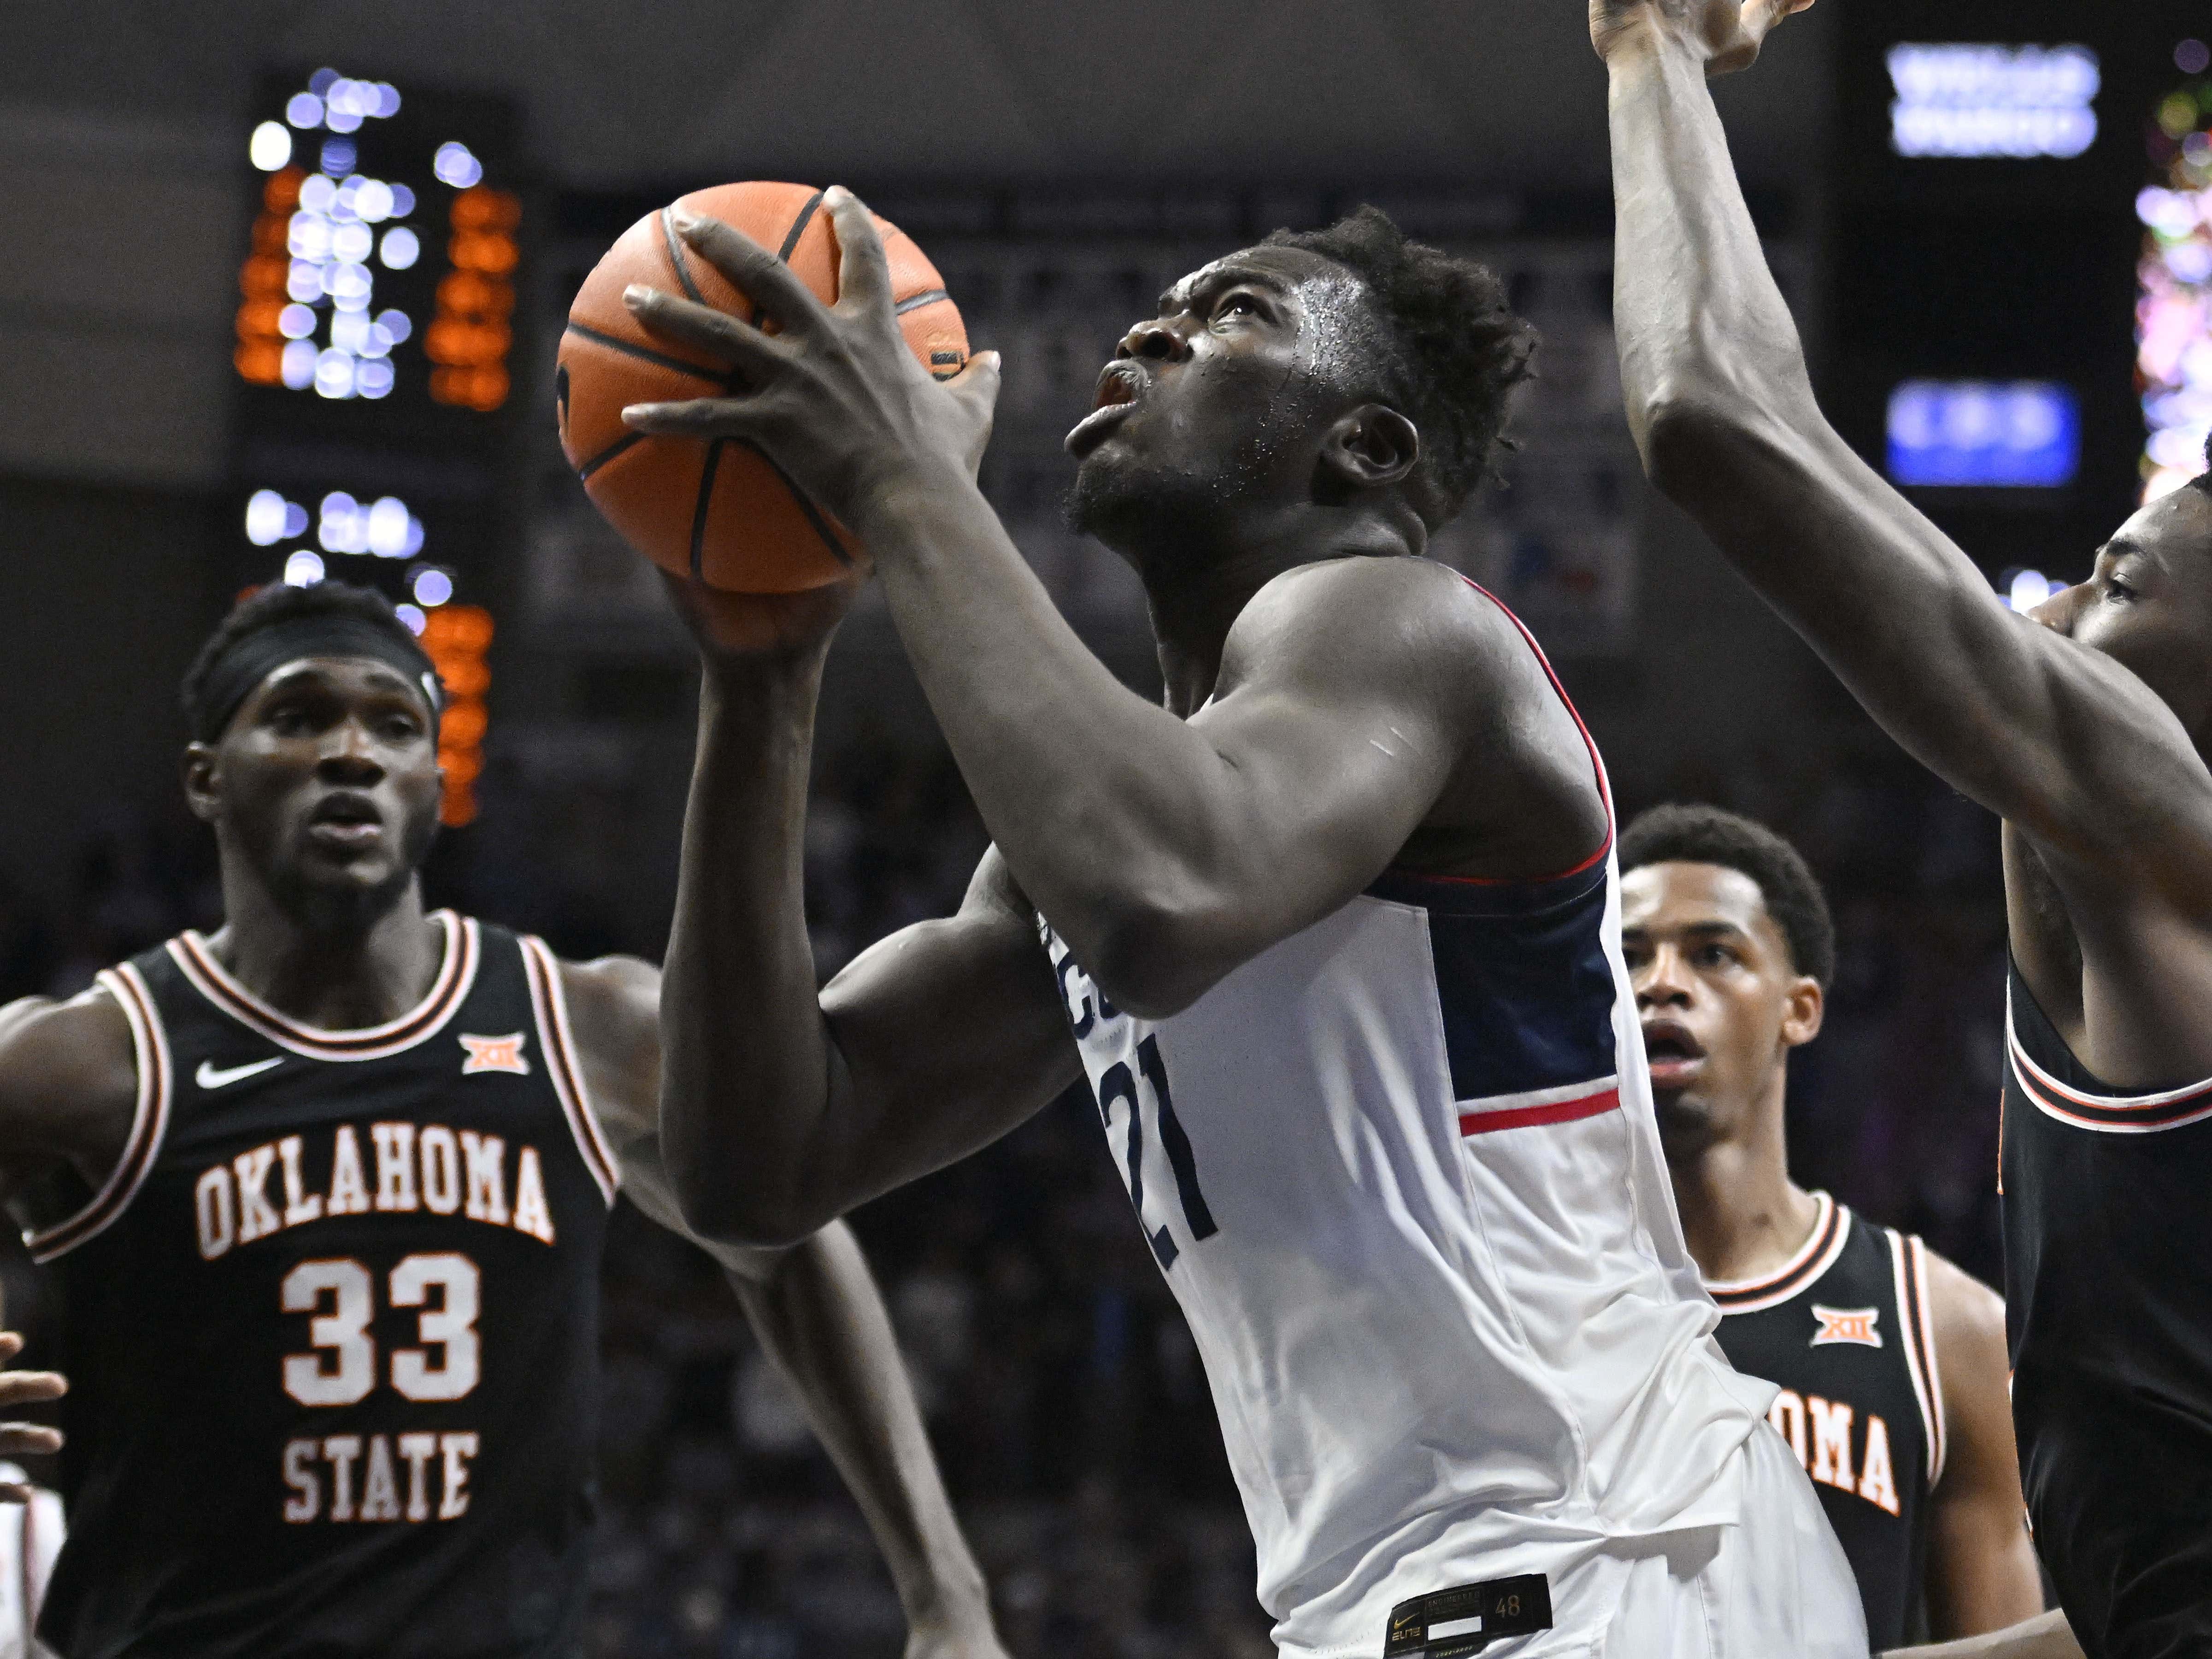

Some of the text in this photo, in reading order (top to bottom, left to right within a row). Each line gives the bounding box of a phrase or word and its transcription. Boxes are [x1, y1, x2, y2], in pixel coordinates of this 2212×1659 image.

[195, 1121, 556, 1261] OKLAHOMA
[1100, 1033, 1218, 1271] 21
[281, 1250, 482, 1408] 33
[1813, 1307, 1879, 1345] XII
[282, 1430, 480, 1523] STATE
[1392, 1626, 1421, 1641] ELITE
[1494, 1595, 1520, 1618] 48
